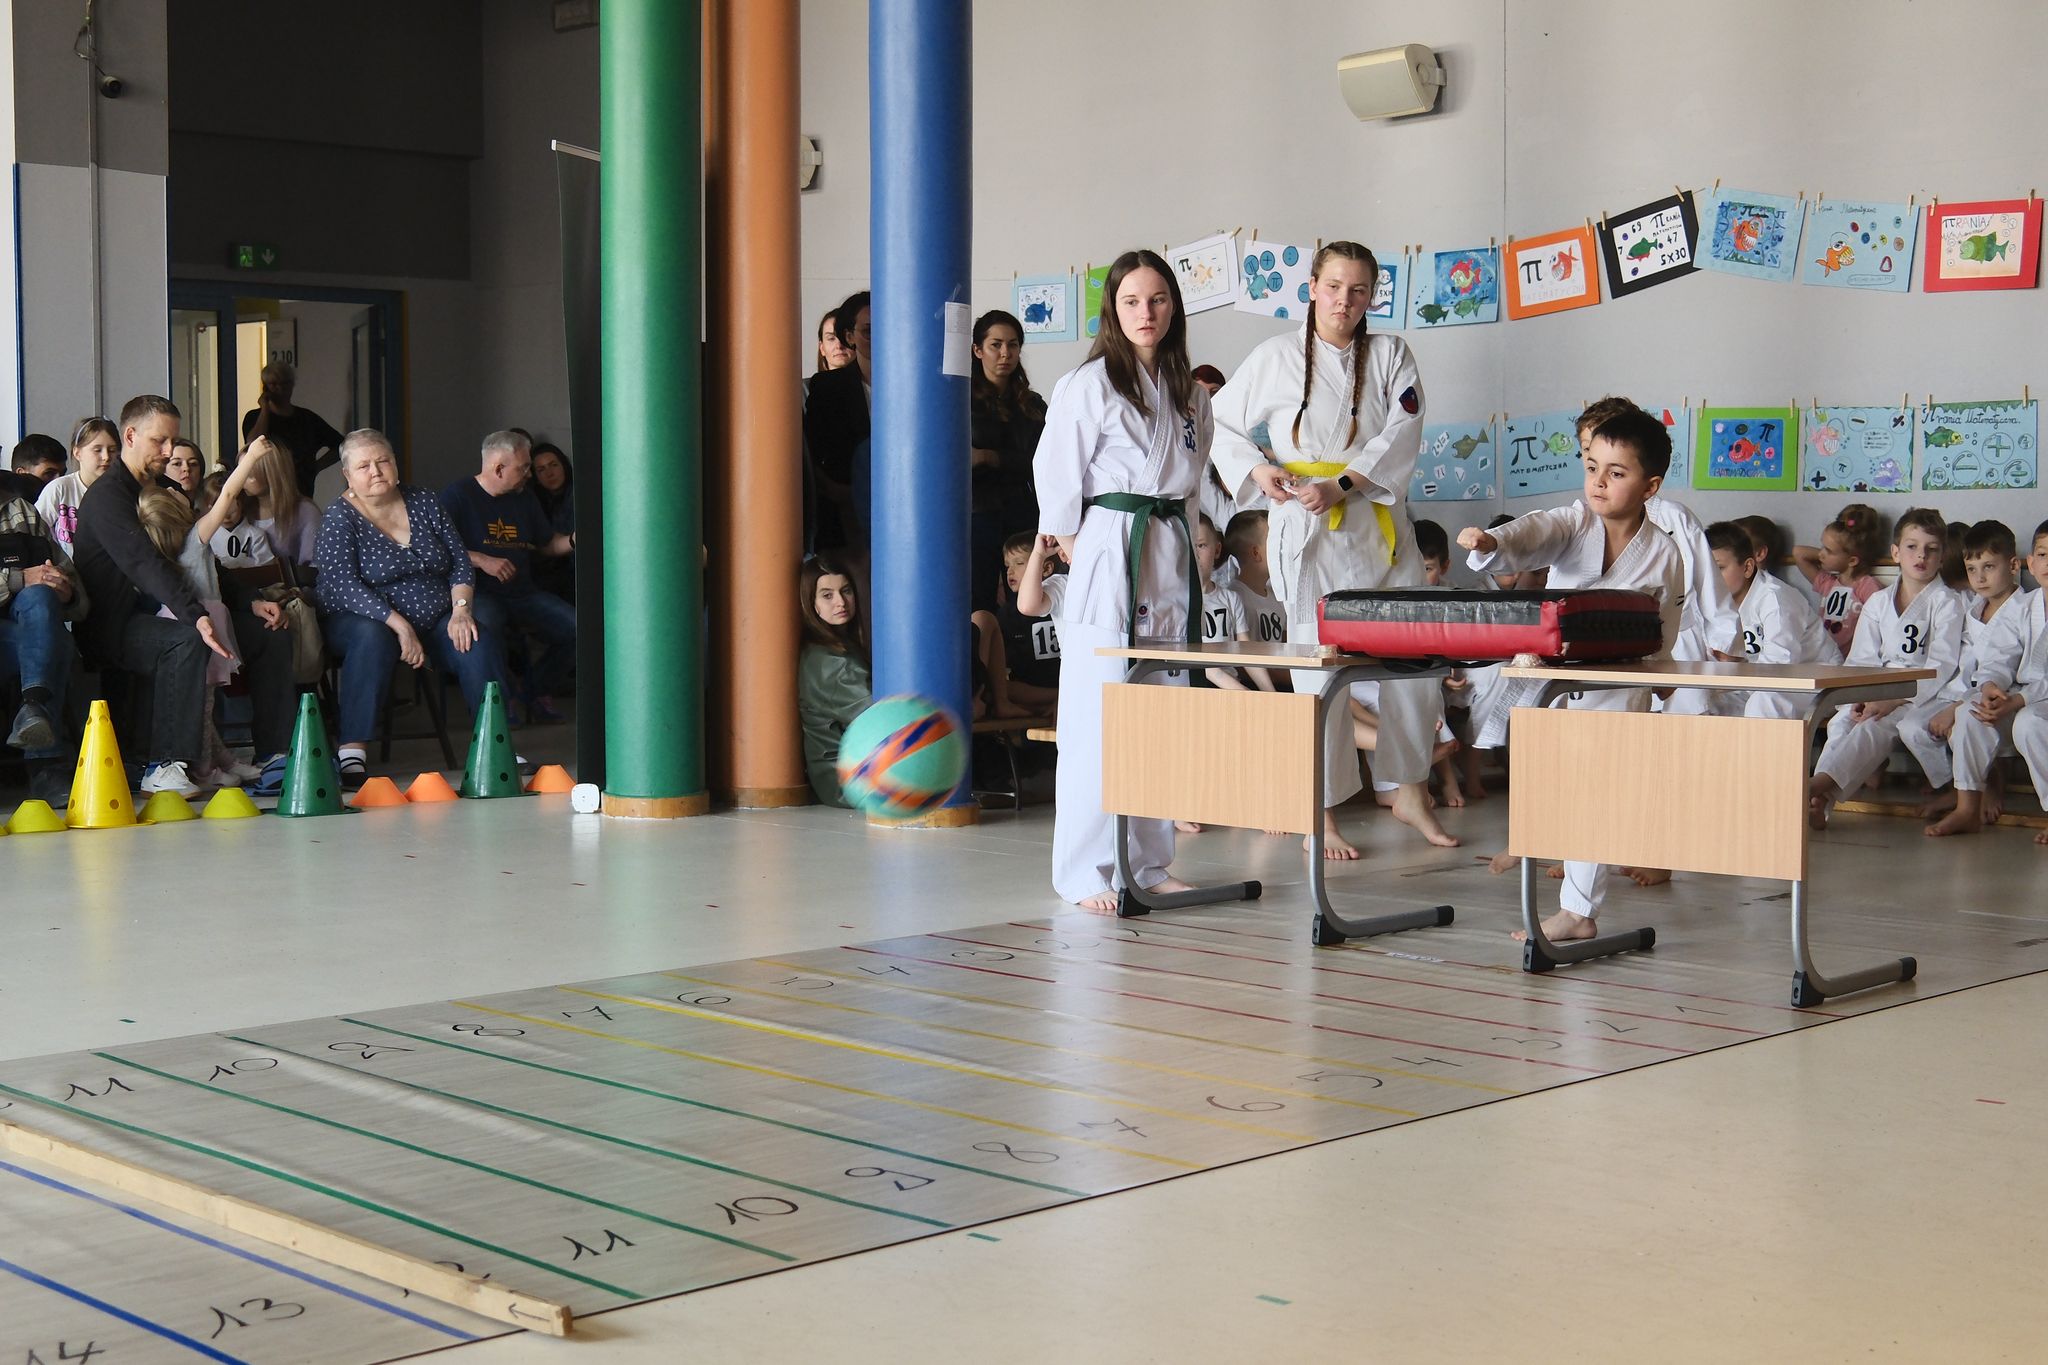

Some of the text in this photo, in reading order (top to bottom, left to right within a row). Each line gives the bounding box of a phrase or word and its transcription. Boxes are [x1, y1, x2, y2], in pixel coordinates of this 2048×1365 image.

[1667, 231, 1678, 244] 47
[227, 535, 252, 559] 04
[1826, 589, 1848, 617] 01
[1260, 611, 1283, 642] 08
[208, 1057, 279, 1082] 10
[63, 1076, 136, 1102] 11
[971, 1141, 1060, 1164] 8
[714, 1196, 800, 1226] 10
[561, 1228, 637, 1262] 11
[209, 1297, 306, 1340] 13
